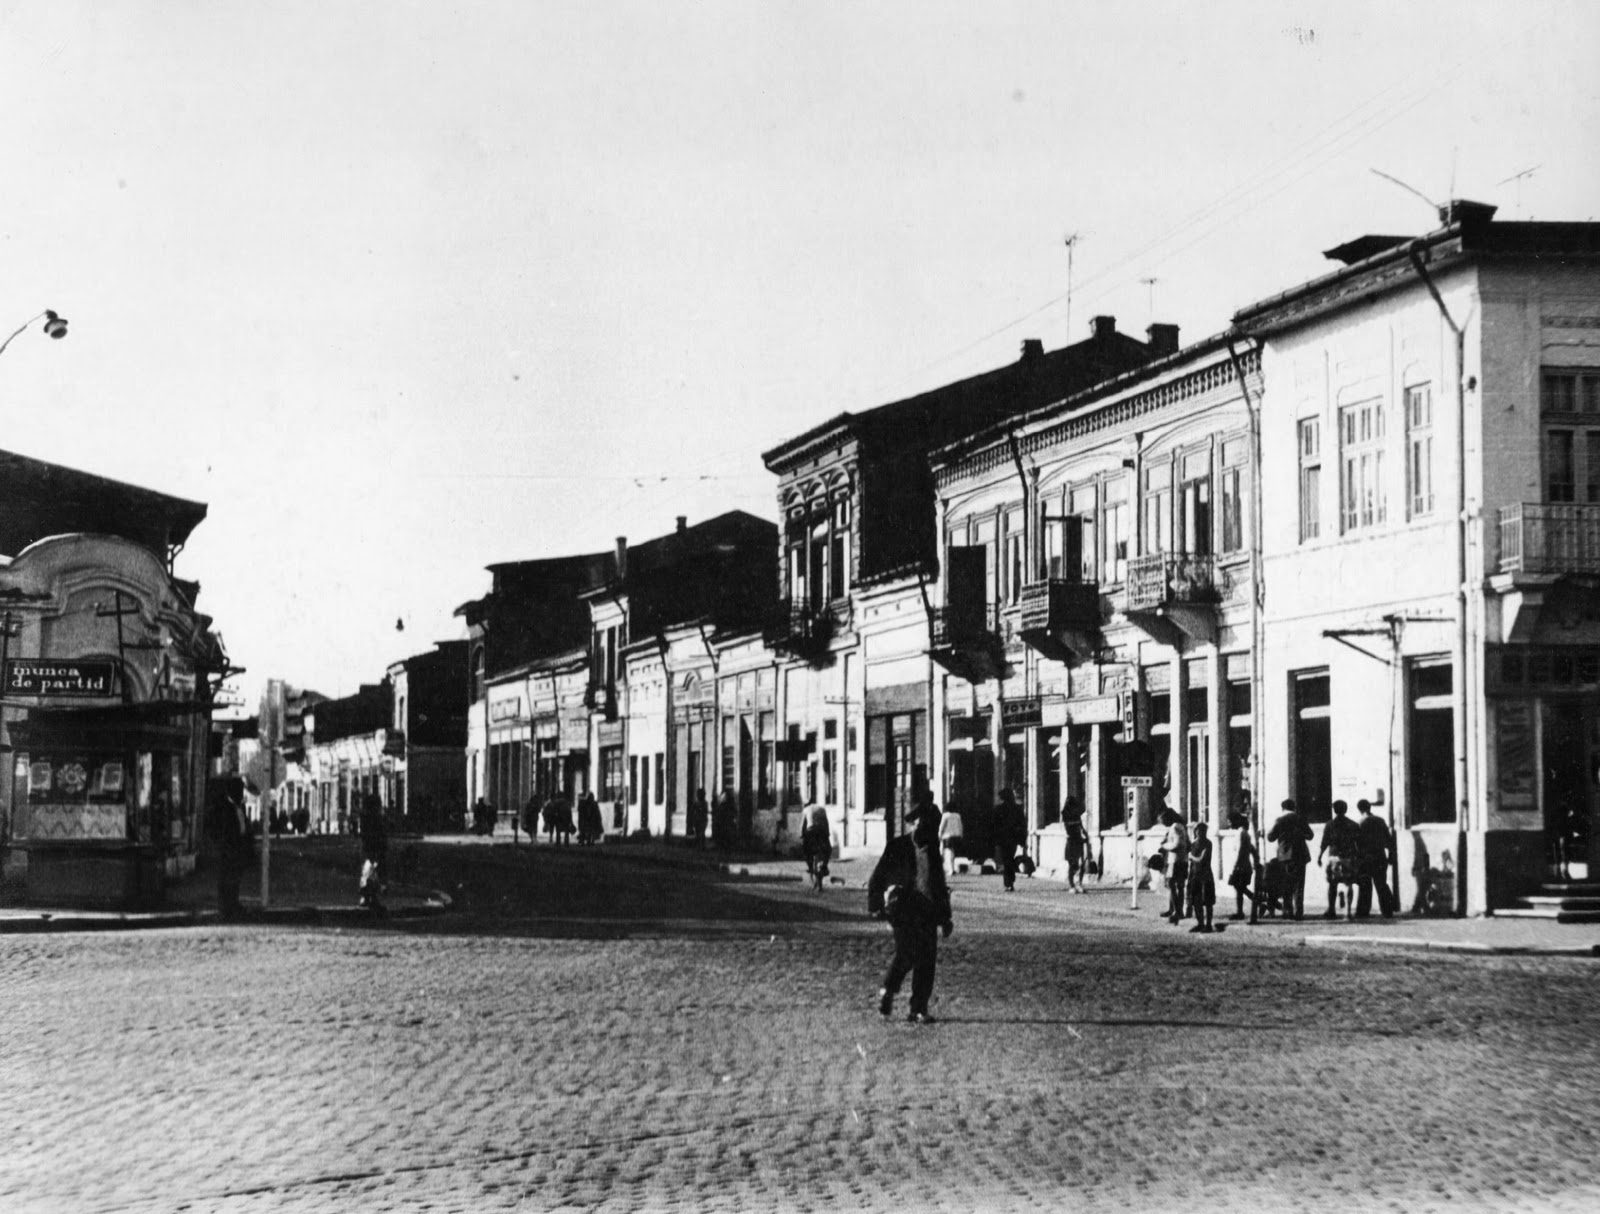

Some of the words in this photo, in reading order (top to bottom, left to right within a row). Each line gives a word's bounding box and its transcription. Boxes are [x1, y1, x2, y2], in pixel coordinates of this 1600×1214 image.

[13, 667, 80, 676] munca
[12, 675, 32, 688] de
[41, 676, 104, 694] partid
